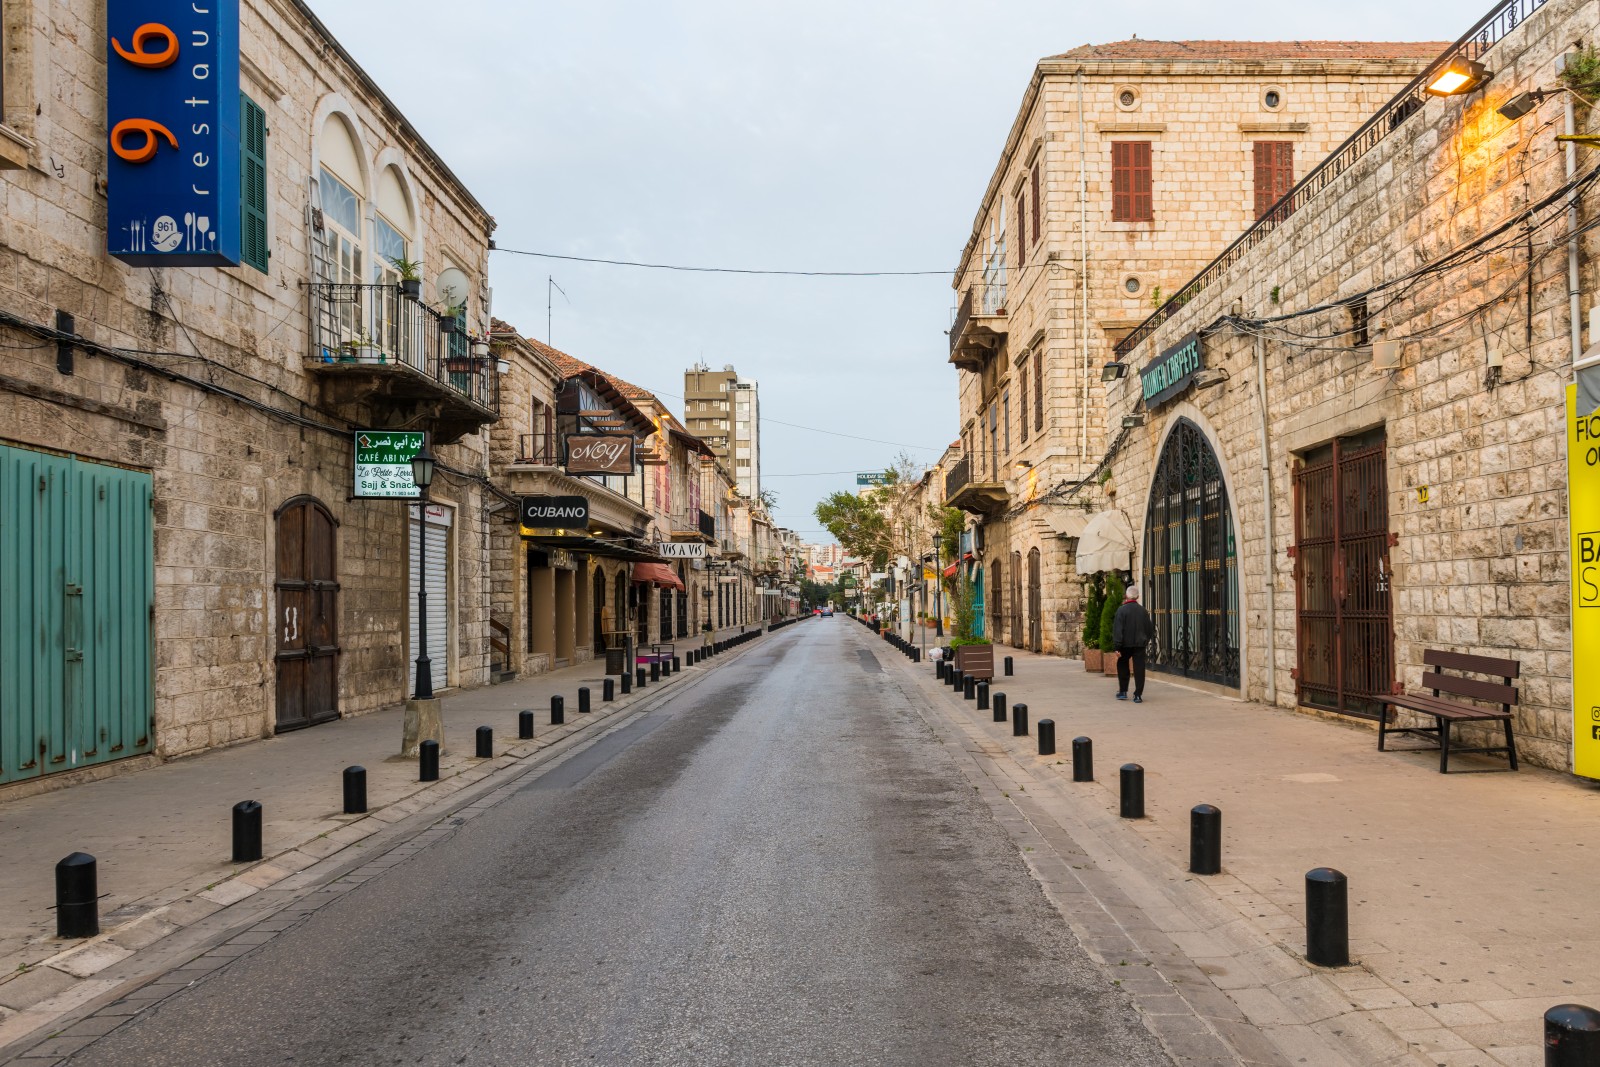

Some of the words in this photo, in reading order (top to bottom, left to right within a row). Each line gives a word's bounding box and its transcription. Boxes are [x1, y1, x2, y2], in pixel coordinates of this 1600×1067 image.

[157, 221, 174, 232] 961
[1166, 340, 1199, 385] CARPETS
[372, 436, 391, 448] نصر
[393, 434, 408, 450] أبي
[358, 452, 379, 462] CAFÉ
[382, 454, 396, 462] ABI
[571, 441, 627, 469] NOY
[1585, 446, 1600, 466] O
[356, 464, 370, 478] La
[361, 480, 378, 490] Sajj
[380, 480, 387, 489] &
[527, 506, 586, 518] CUBANO
[678, 544, 686, 556] A
